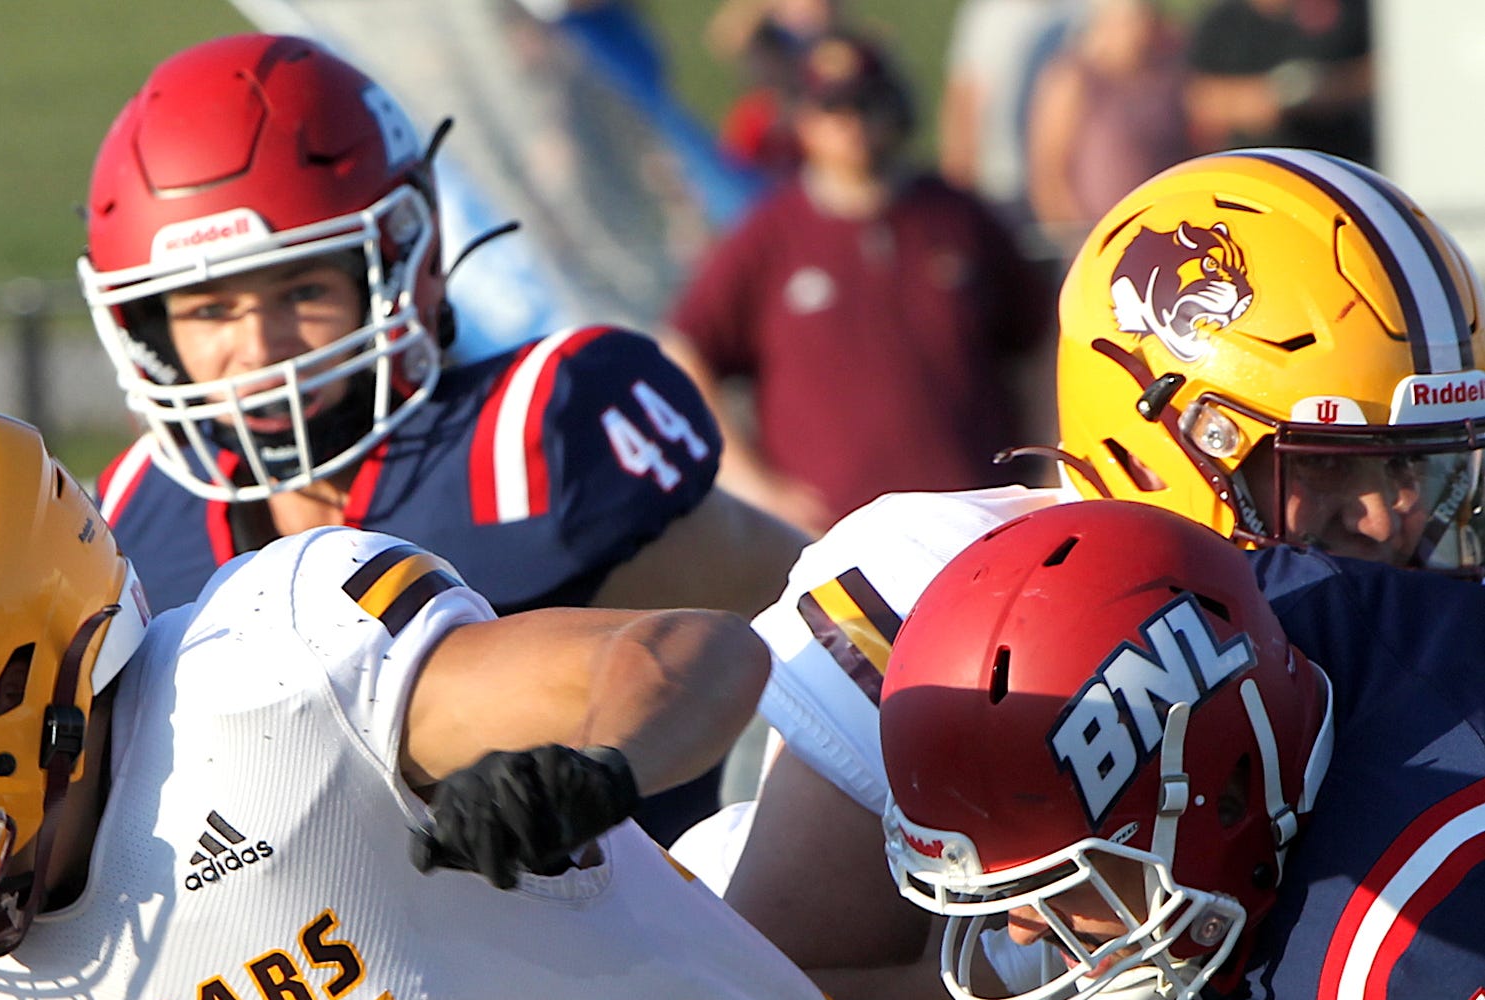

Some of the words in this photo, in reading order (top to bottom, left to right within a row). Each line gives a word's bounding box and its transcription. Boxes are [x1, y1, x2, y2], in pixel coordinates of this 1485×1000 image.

[600, 379, 709, 491] 44
[1046, 592, 1257, 831] BNL
[185, 837, 274, 892] adidas
